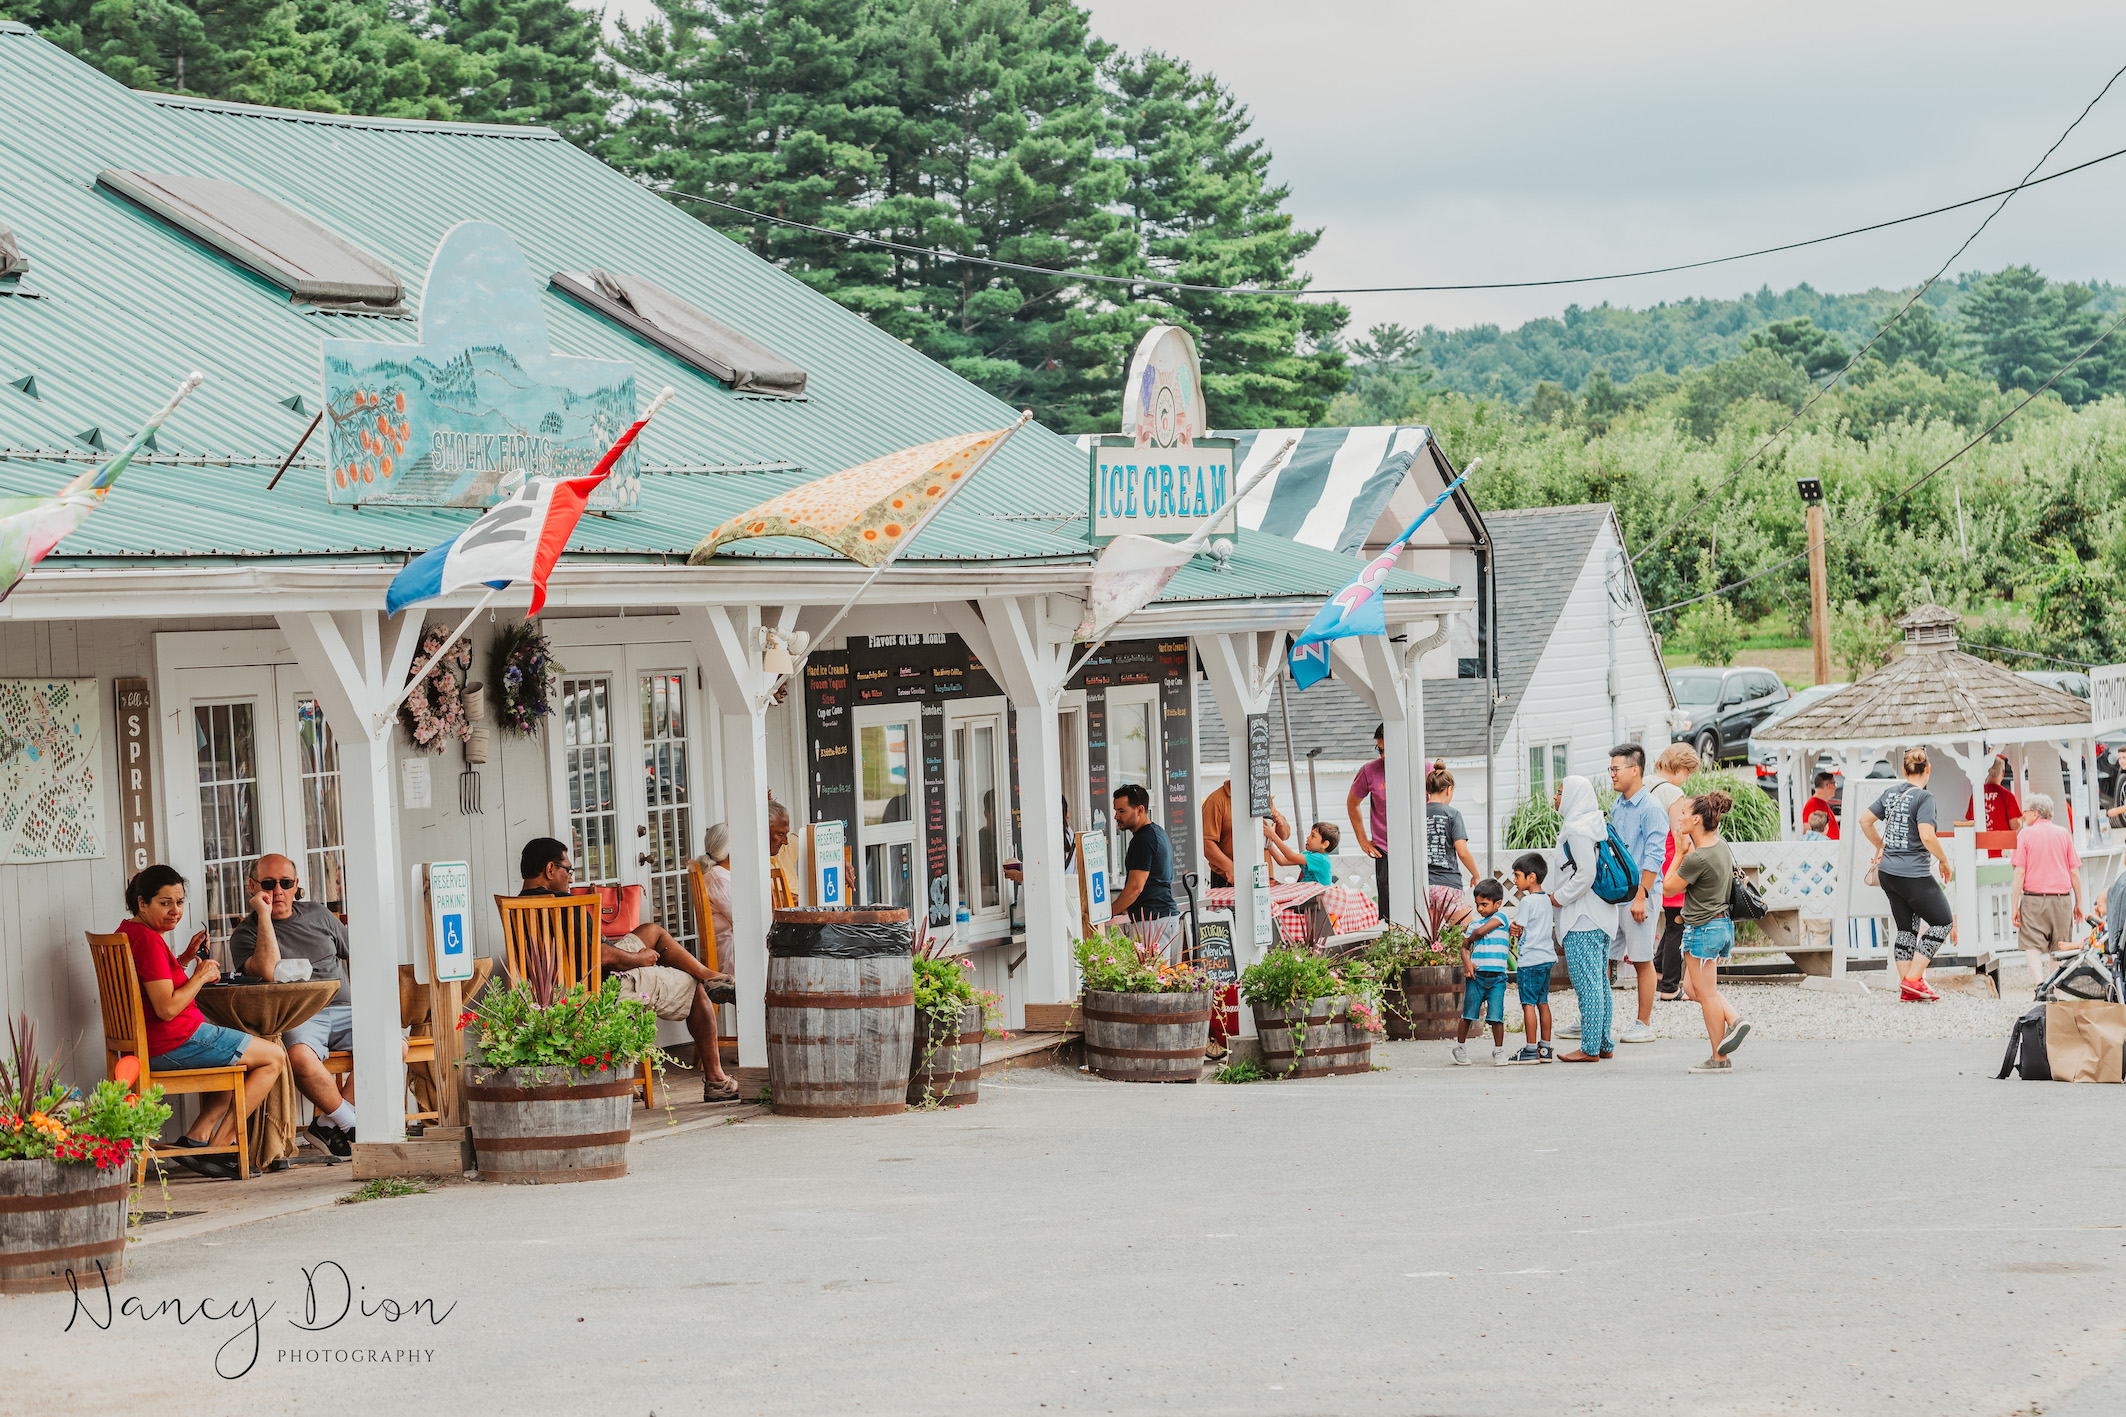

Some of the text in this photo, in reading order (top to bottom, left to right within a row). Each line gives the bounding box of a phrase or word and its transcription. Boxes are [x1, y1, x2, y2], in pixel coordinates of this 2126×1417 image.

[432, 430, 552, 475] SMOLAK FARMS
[1099, 464, 1228, 518] ICE CREAM
[868, 633, 947, 648] Flavors of the Month
[807, 664, 819, 676] Hard
[828, 664, 844, 676] Cream
[810, 678, 847, 690] Frozen Yogurt
[127, 692, 143, 708] hello
[822, 693, 836, 705] Sizes
[817, 708, 826, 720] Cup
[832, 706, 843, 716] Cone
[921, 703, 943, 717] Sundaes
[127, 714, 148, 871] SPRING
[817, 832, 842, 847] RESERVED
[1084, 839, 1105, 855] RESERVED
[819, 849, 841, 864] PARKING
[1088, 855, 1105, 869] PARKING
[433, 873, 467, 889] RESERVED
[436, 893, 466, 910] PARKING
[1201, 958, 1229, 973] PEACH
